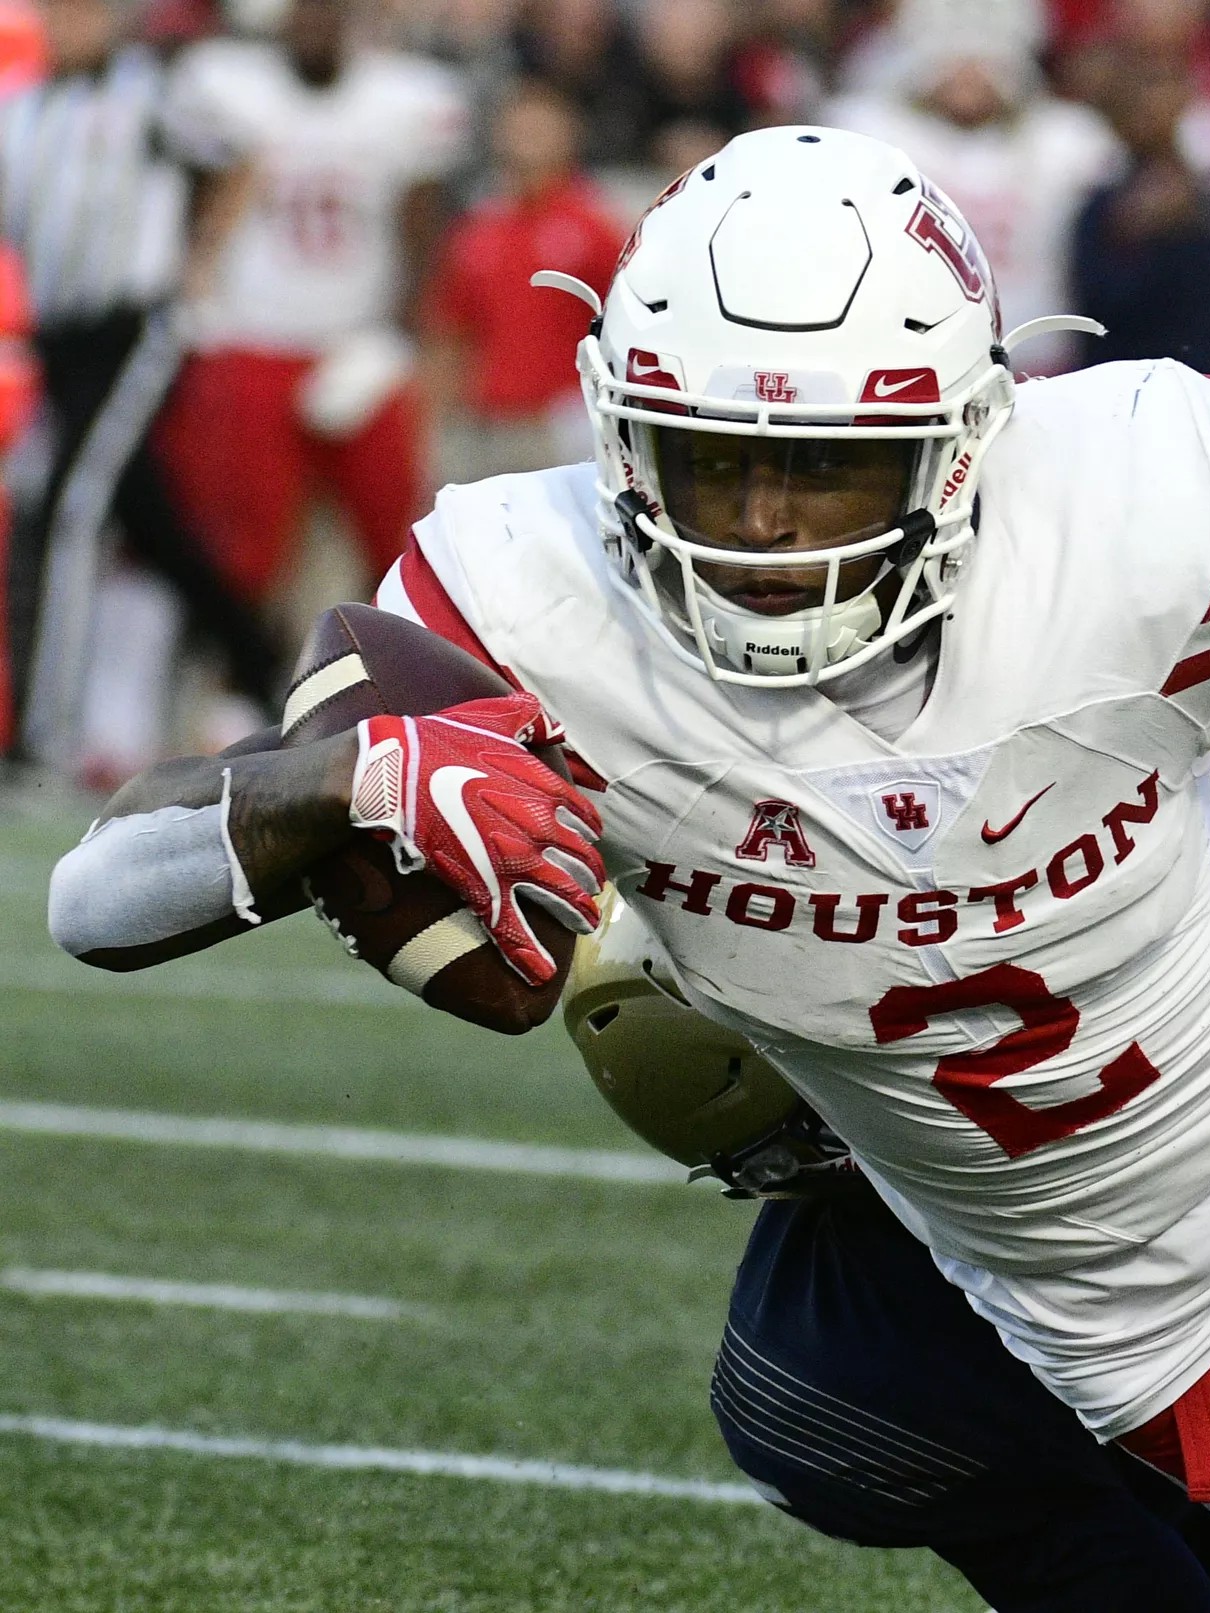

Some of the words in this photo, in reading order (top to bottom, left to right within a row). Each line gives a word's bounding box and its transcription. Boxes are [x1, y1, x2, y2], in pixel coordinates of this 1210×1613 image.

[754, 372, 797, 403] UH
[745, 641, 800, 656] Riddell
[735, 798, 817, 868] A
[881, 792, 930, 832] UH
[635, 768, 1159, 948] HOUSTON
[868, 962, 1162, 1160] 2
